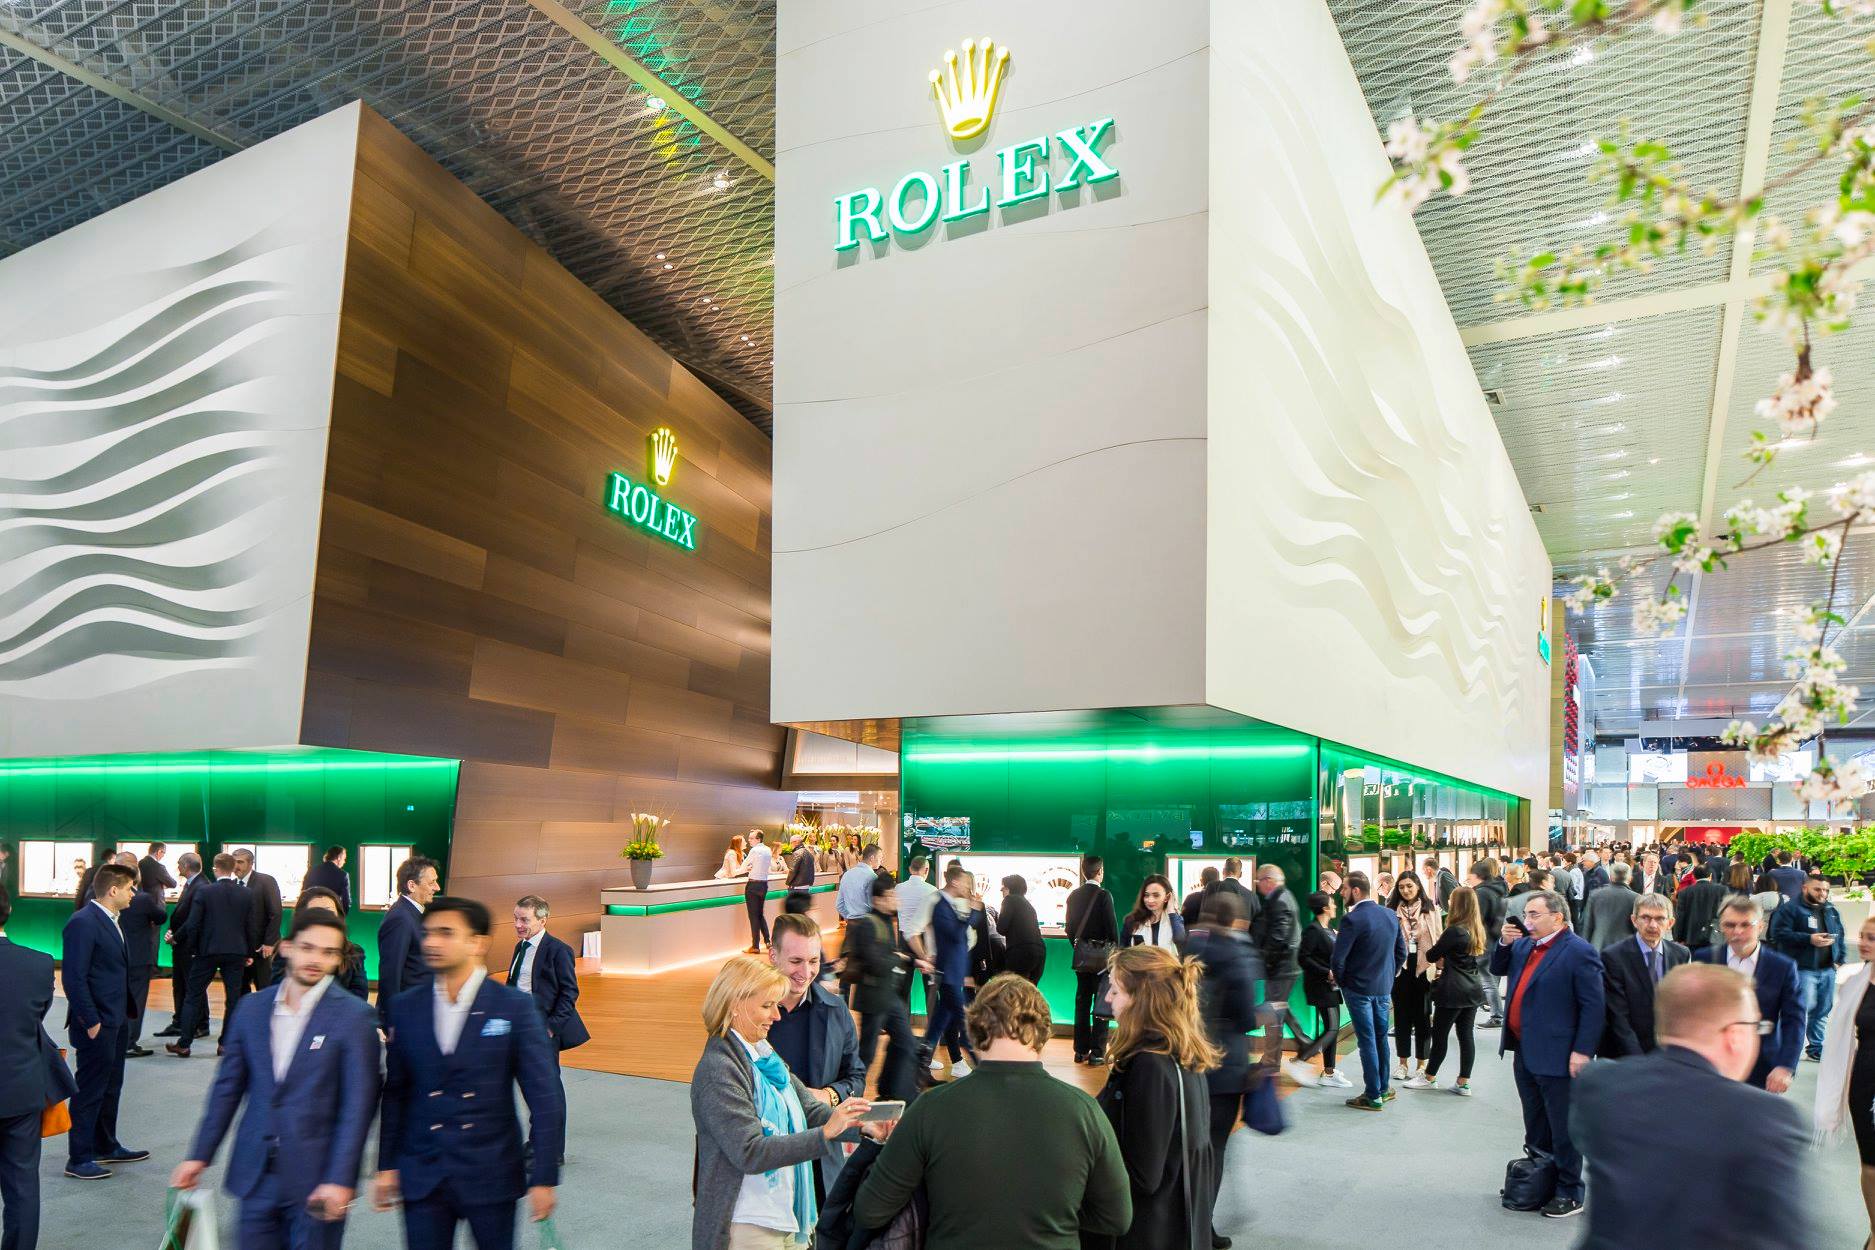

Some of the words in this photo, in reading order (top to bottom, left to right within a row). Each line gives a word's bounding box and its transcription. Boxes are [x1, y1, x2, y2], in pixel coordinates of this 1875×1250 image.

[834, 117, 1120, 251] ROLEX
[608, 472, 698, 551] ROLEX
[1685, 775, 1746, 788] OMEGA
